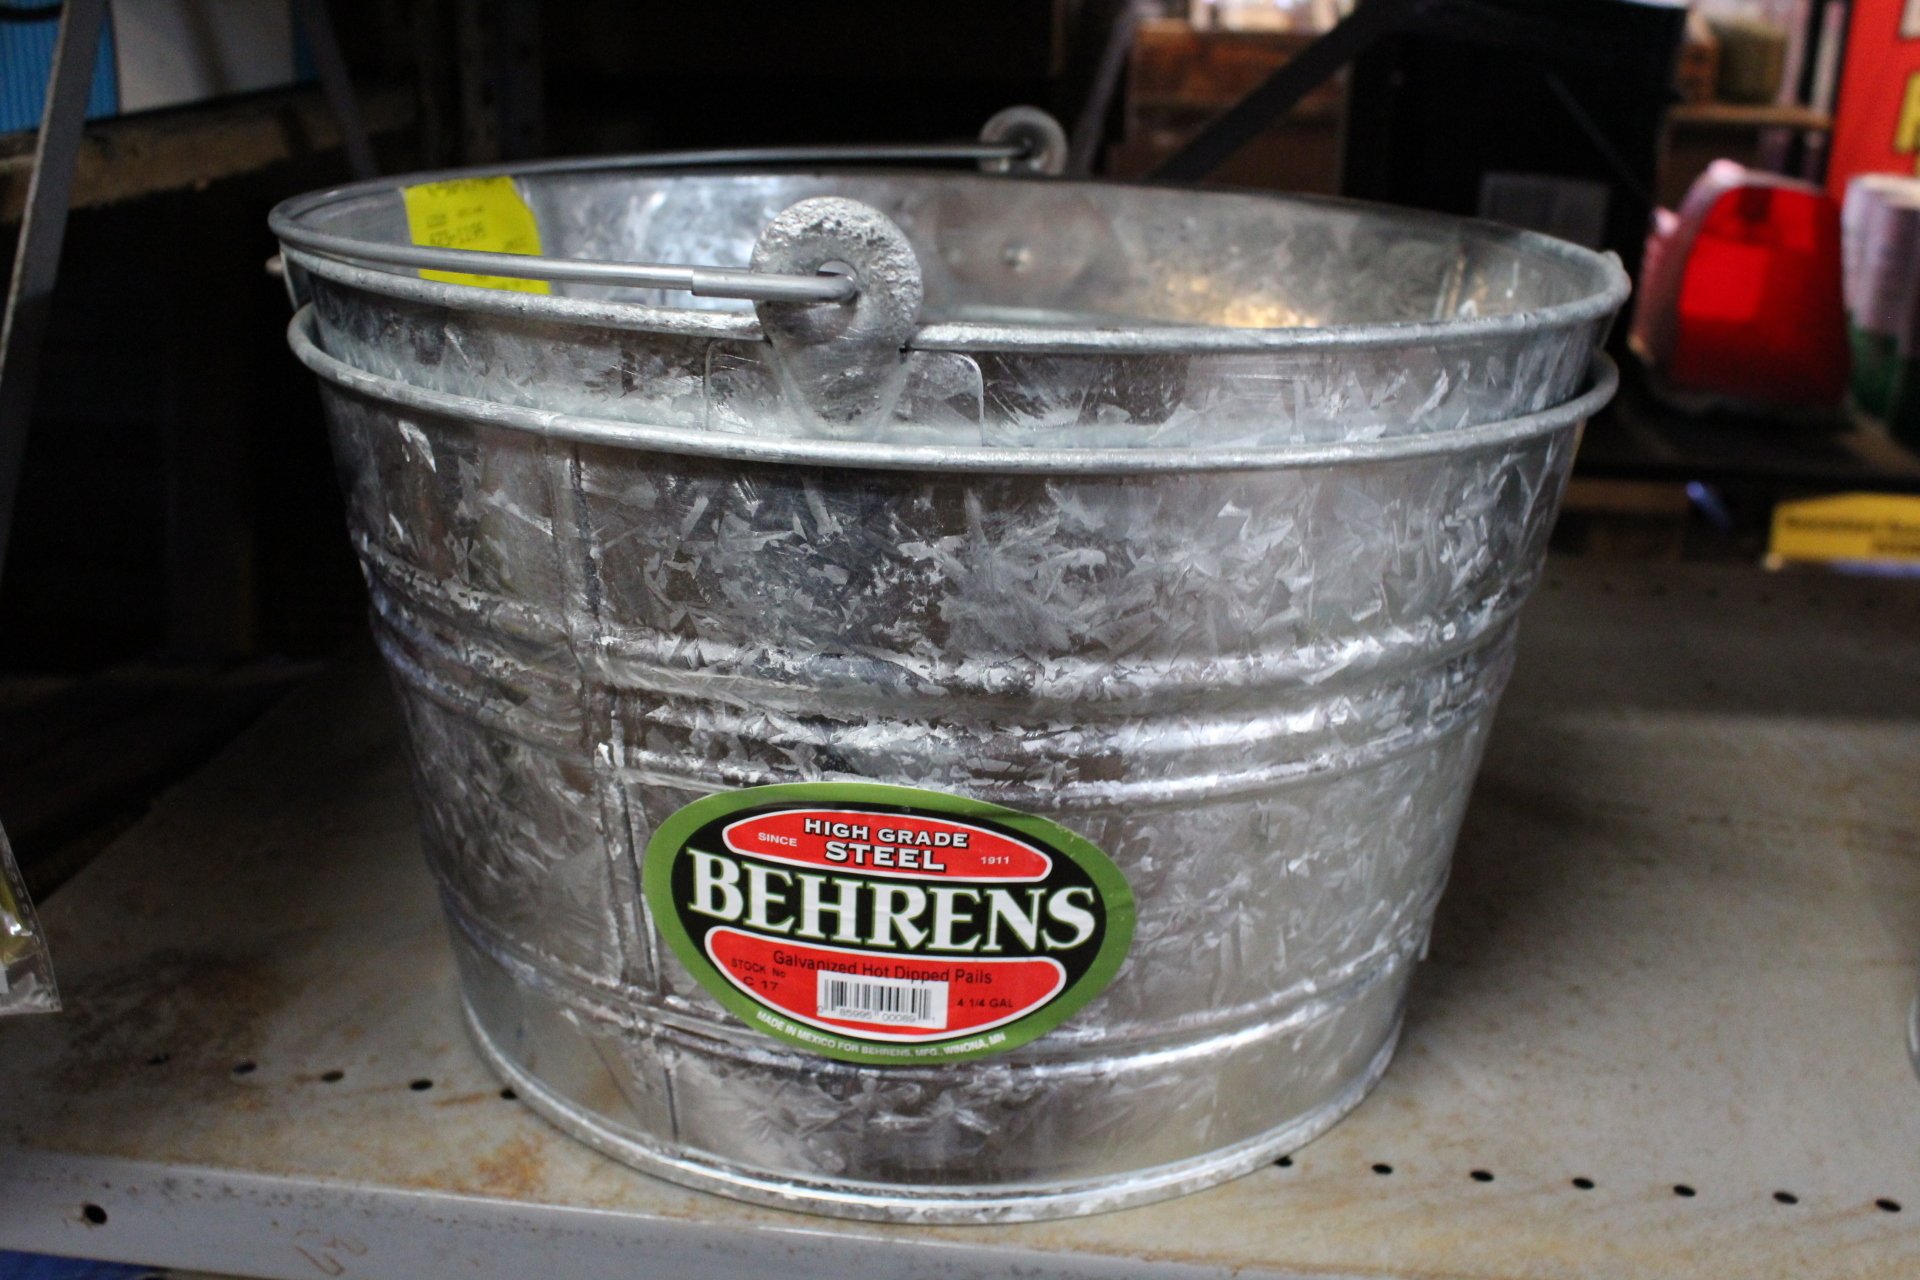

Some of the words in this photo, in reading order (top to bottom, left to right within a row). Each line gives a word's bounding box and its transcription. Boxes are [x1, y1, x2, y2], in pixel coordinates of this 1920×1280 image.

[758, 832, 797, 847] SINCE
[804, 818, 868, 841] HIGH
[877, 828, 969, 848] GRADE
[825, 841, 946, 872] STEEL
[980, 856, 1010, 865] 1911
[686, 847, 1096, 952] BEHRENS
[731, 958, 766, 973] STOCK
[773, 950, 857, 975] Galvanized
[862, 963, 889, 978] Hot
[894, 966, 949, 985] Dipped
[955, 969, 993, 984] Pails
[761, 980, 778, 991] 17
[989, 998, 1013, 1008] GAL
[756, 1010, 784, 1031] MADE
[785, 1024, 796, 1036] IN
[796, 1029, 836, 1049] MEXICO
[837, 1042, 859, 1052] FOR
